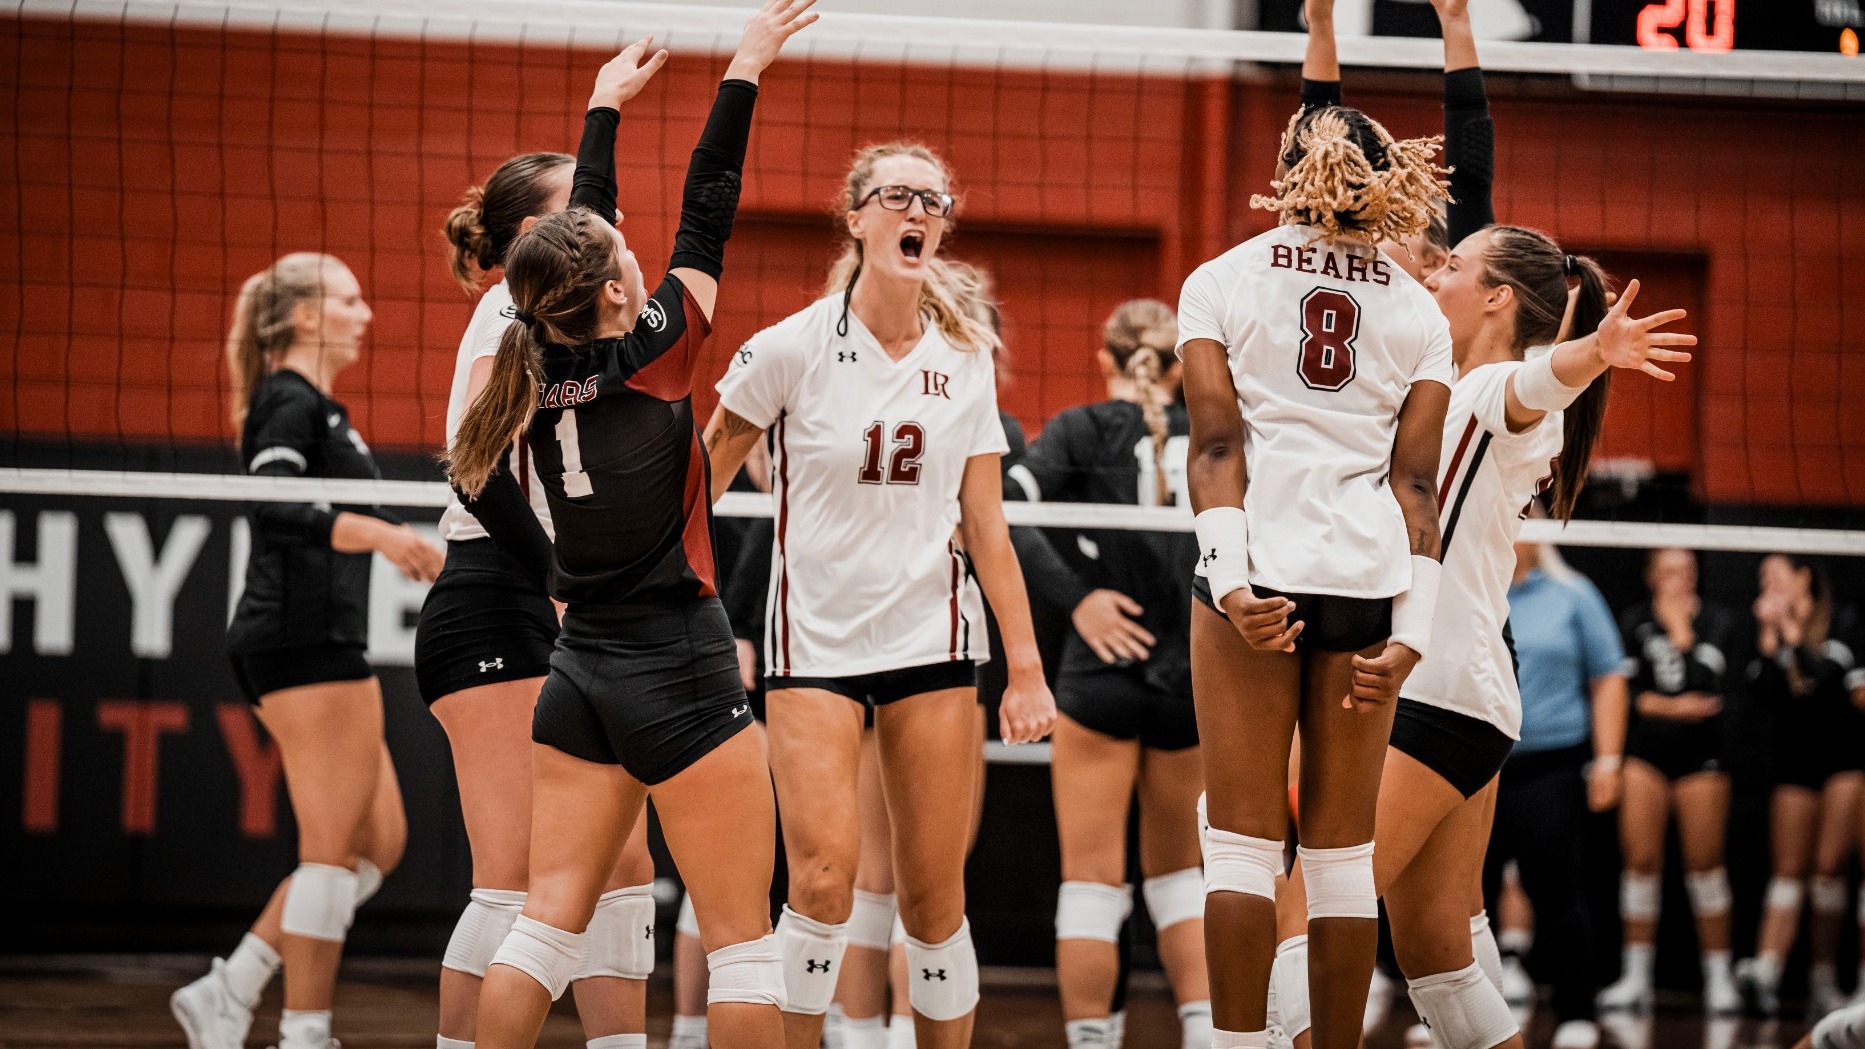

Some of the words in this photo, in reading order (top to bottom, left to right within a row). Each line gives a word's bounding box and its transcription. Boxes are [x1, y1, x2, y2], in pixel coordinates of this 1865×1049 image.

[1636, 0, 1735, 53] 20
[1270, 244, 1391, 286] BEARS
[1296, 285, 1362, 393] 8
[920, 369, 951, 400] LR
[555, 408, 594, 498] 1
[857, 420, 926, 485] 12
[22, 702, 283, 838] ITY
